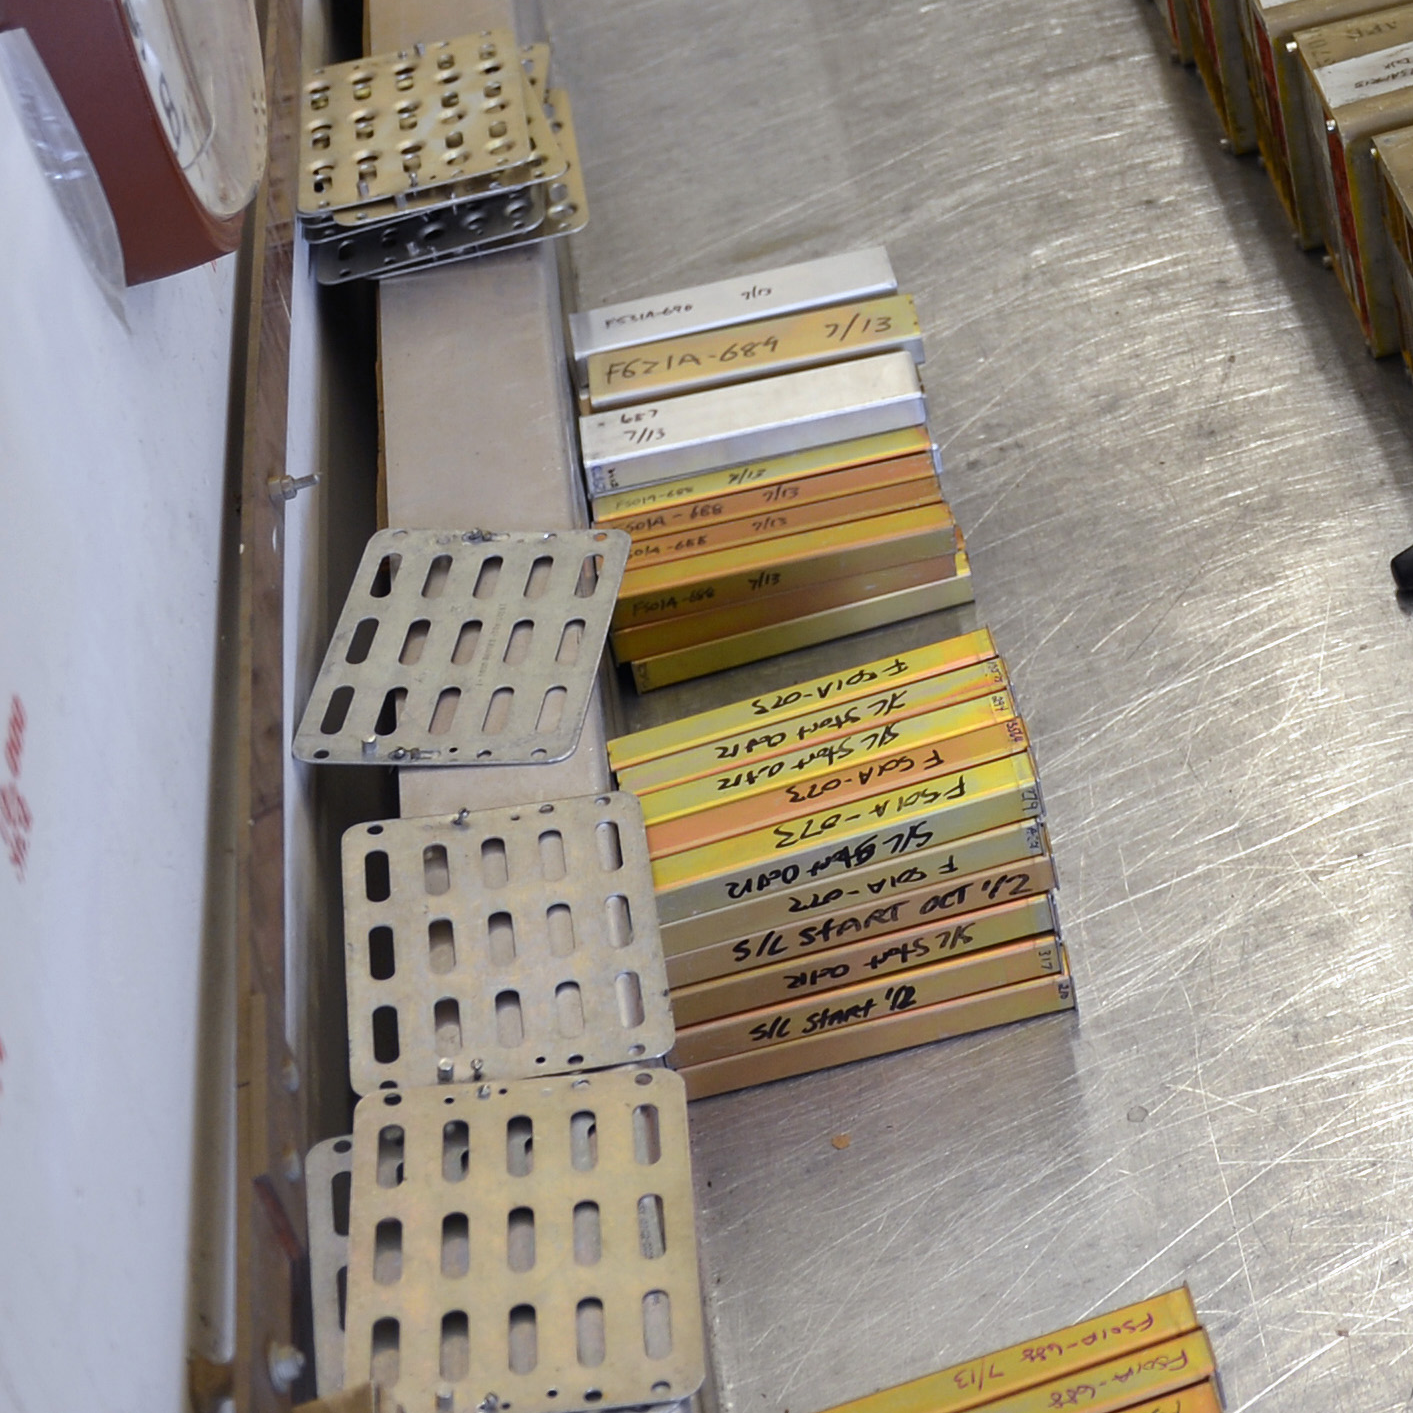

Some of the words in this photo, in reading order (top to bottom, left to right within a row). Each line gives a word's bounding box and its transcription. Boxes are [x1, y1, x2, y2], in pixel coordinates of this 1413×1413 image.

[825, 312, 892, 342] 7/13
[624, 427, 665, 444] 7/13
[919, 884, 967, 915] OCT
[1038, 950, 1053, 970] 317
[954, 1357, 1005, 1391] 7/13
